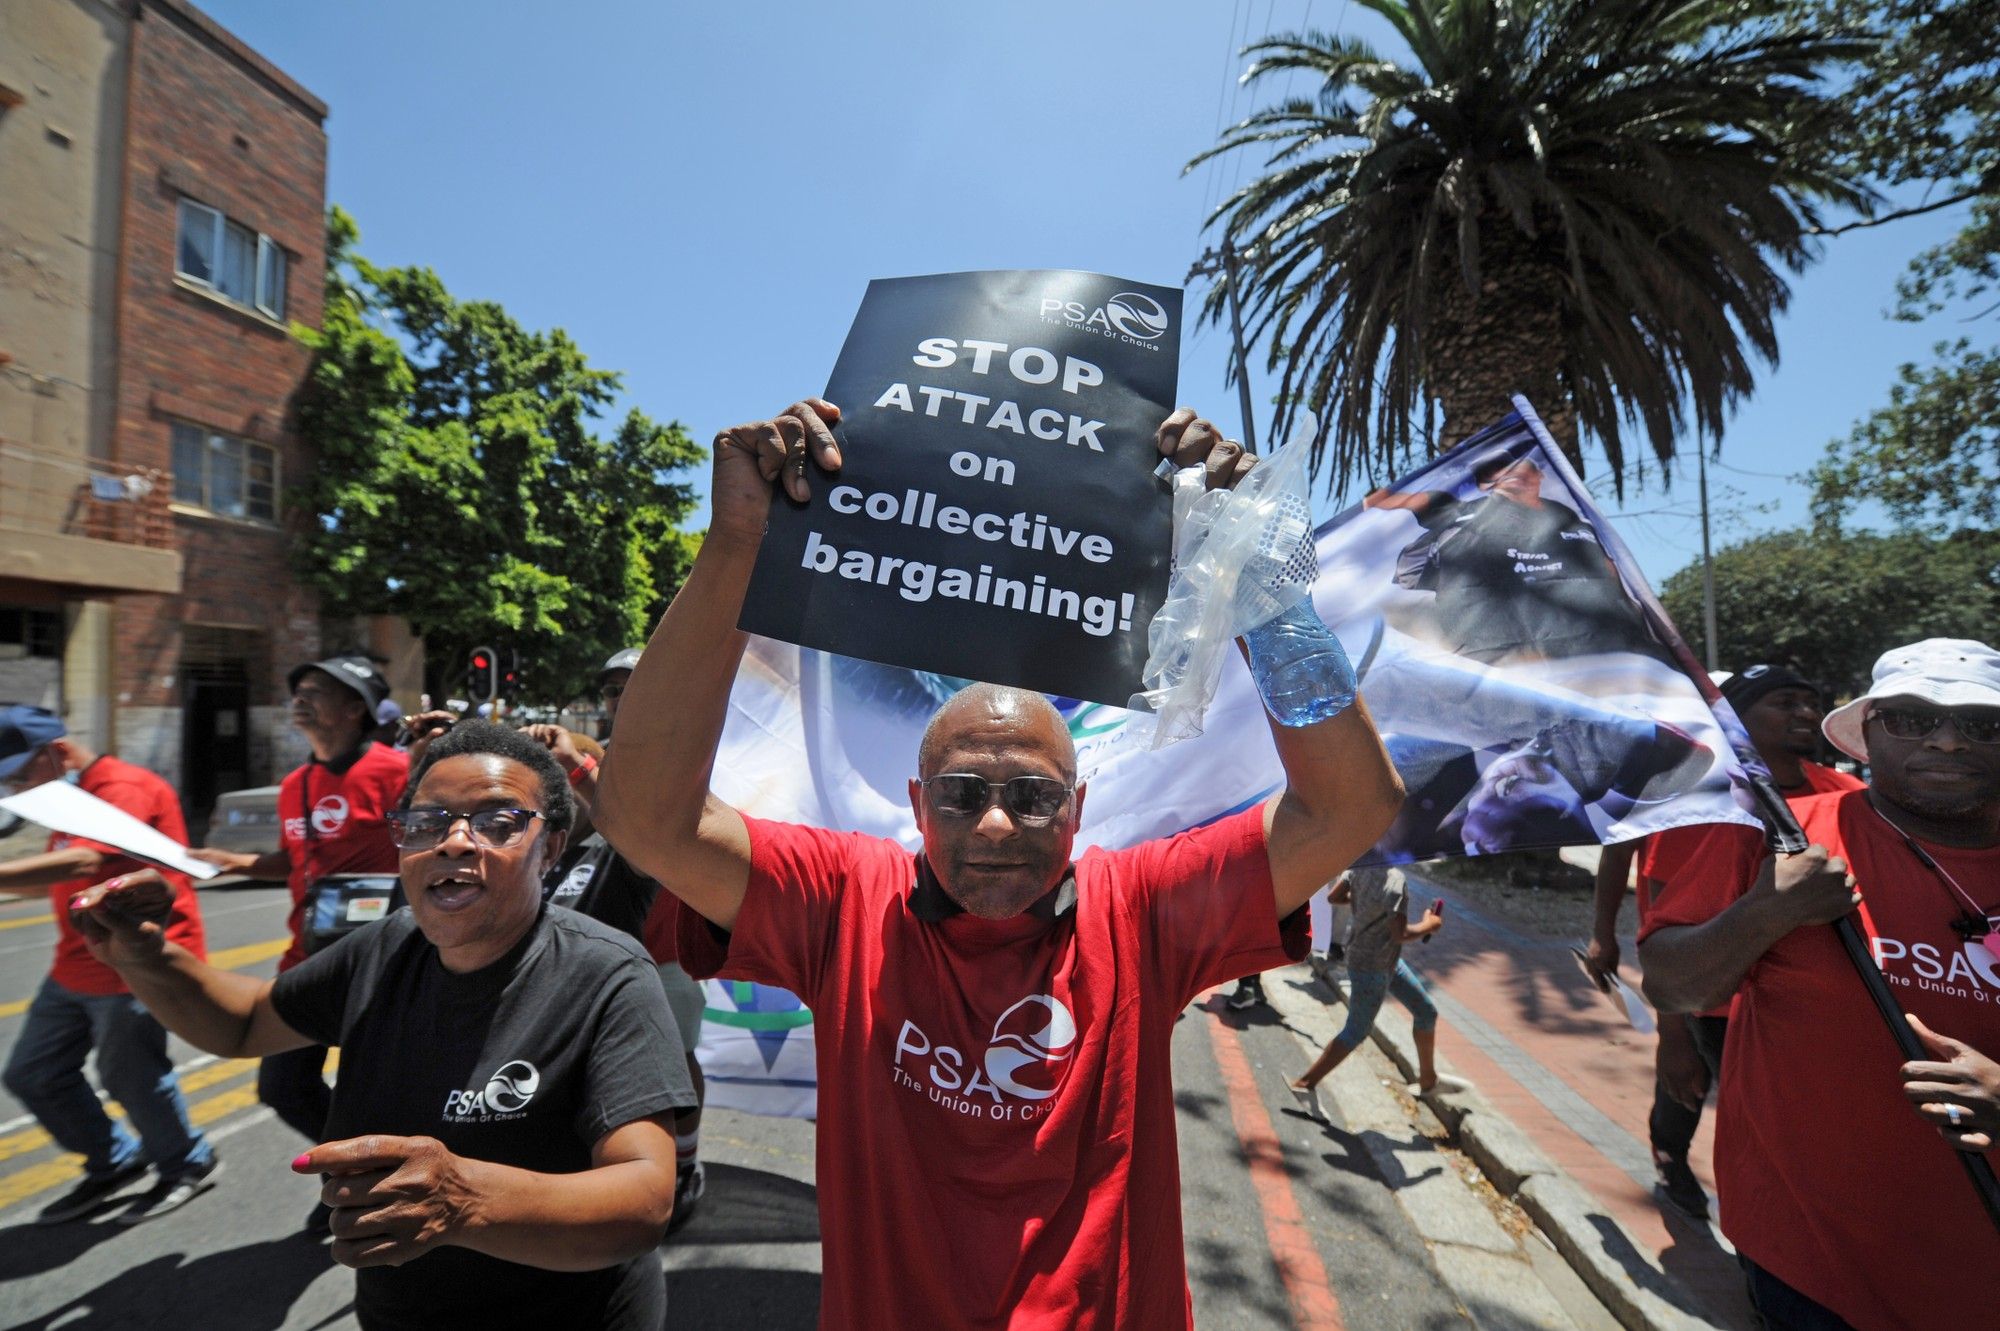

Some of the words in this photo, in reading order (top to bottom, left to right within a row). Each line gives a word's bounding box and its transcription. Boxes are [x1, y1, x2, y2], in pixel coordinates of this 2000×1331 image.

[1040, 299, 1111, 330] PSA
[1040, 316, 1060, 325] The
[1066, 321, 1099, 334] Union
[1104, 327, 1117, 339] Of
[1121, 333, 1160, 352] Choice
[913, 338, 1104, 394] STOP
[873, 383, 1106, 452] ATTACK
[950, 451, 1016, 486] on
[828, 485, 1114, 563] collective
[801, 531, 1135, 637] bargaining!
[1872, 937, 1981, 989] PSA
[1918, 979, 1967, 998] Union
[895, 1019, 1003, 1103] PSA
[443, 1090, 487, 1115] PSA
[494, 1112, 528, 1121] Choice
[893, 1067, 922, 1092] The
[929, 1087, 981, 1117] Union
[991, 1104, 1013, 1120] Of
